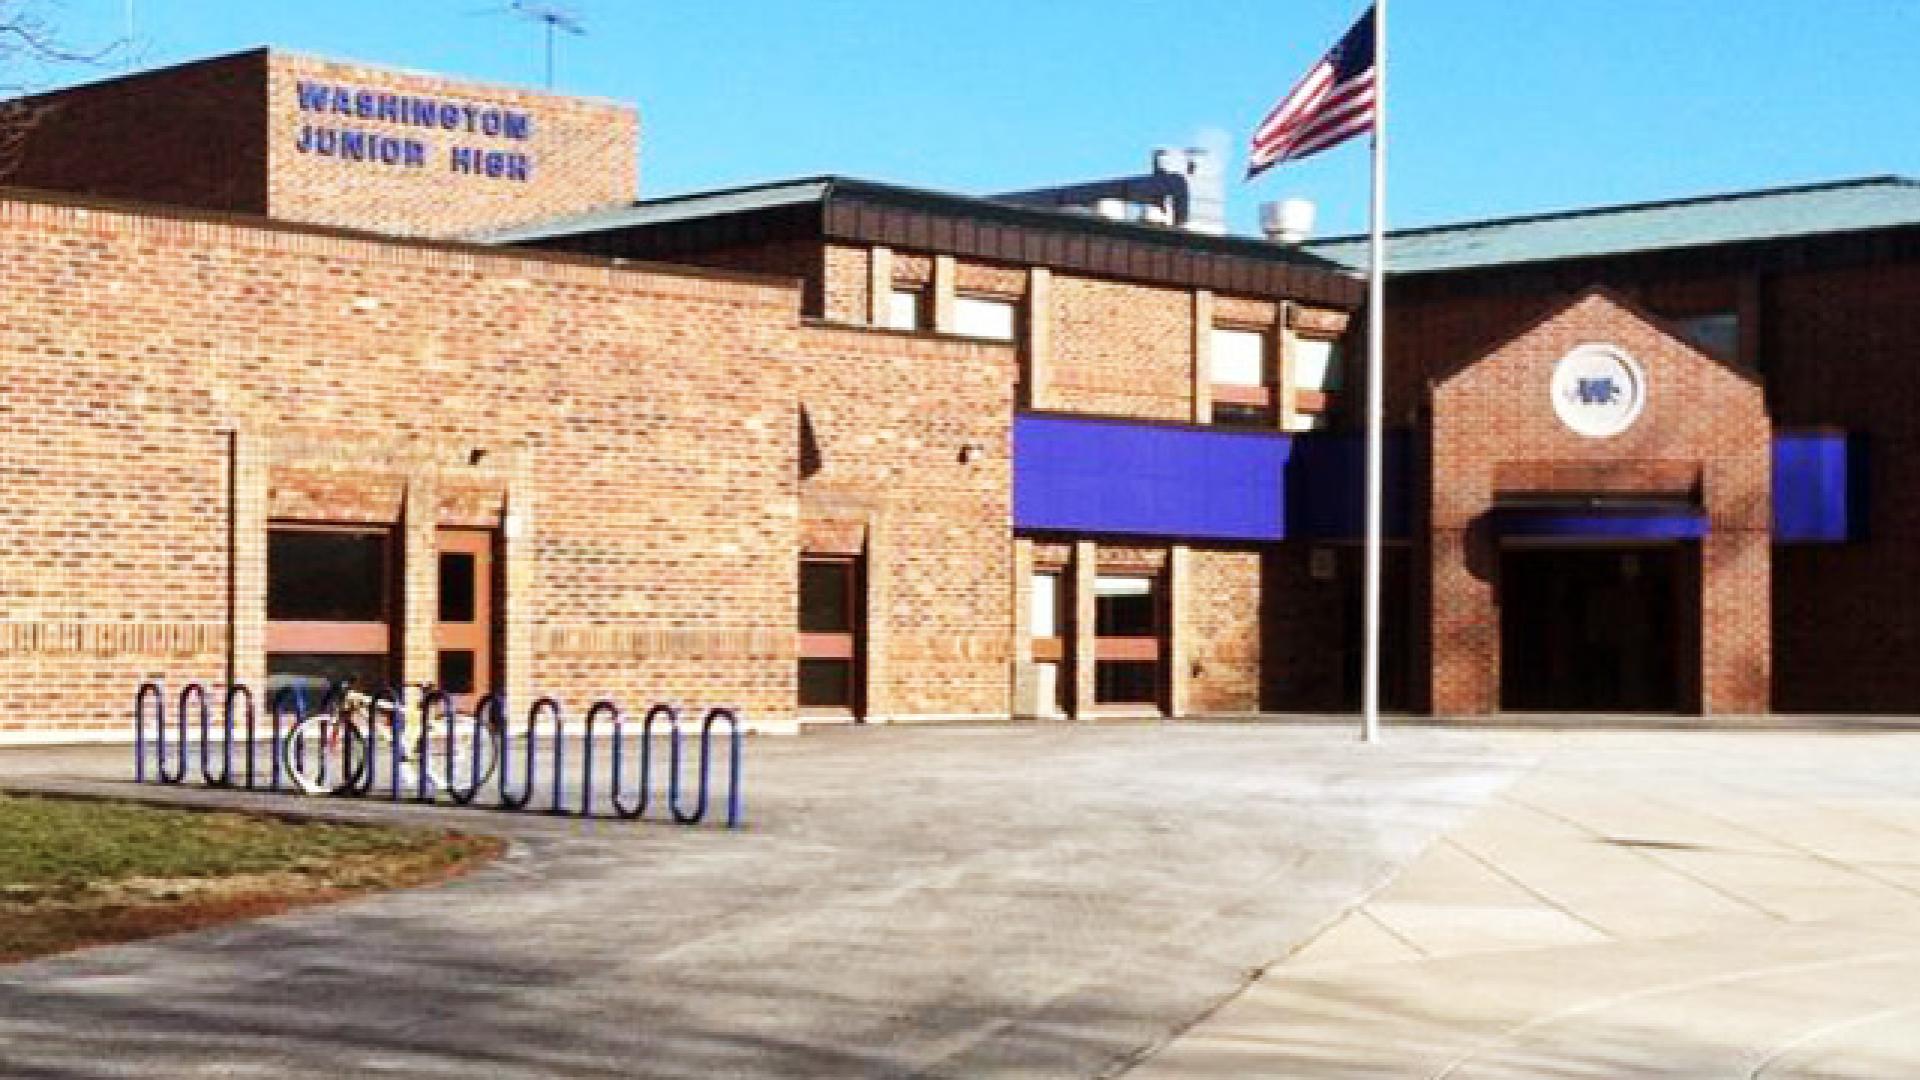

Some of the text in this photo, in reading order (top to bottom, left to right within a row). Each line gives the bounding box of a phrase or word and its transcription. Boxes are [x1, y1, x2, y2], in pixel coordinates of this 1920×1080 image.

[296, 81, 530, 140] WASHINGTON
[296, 126, 530, 182] JUNIOR HIGH
